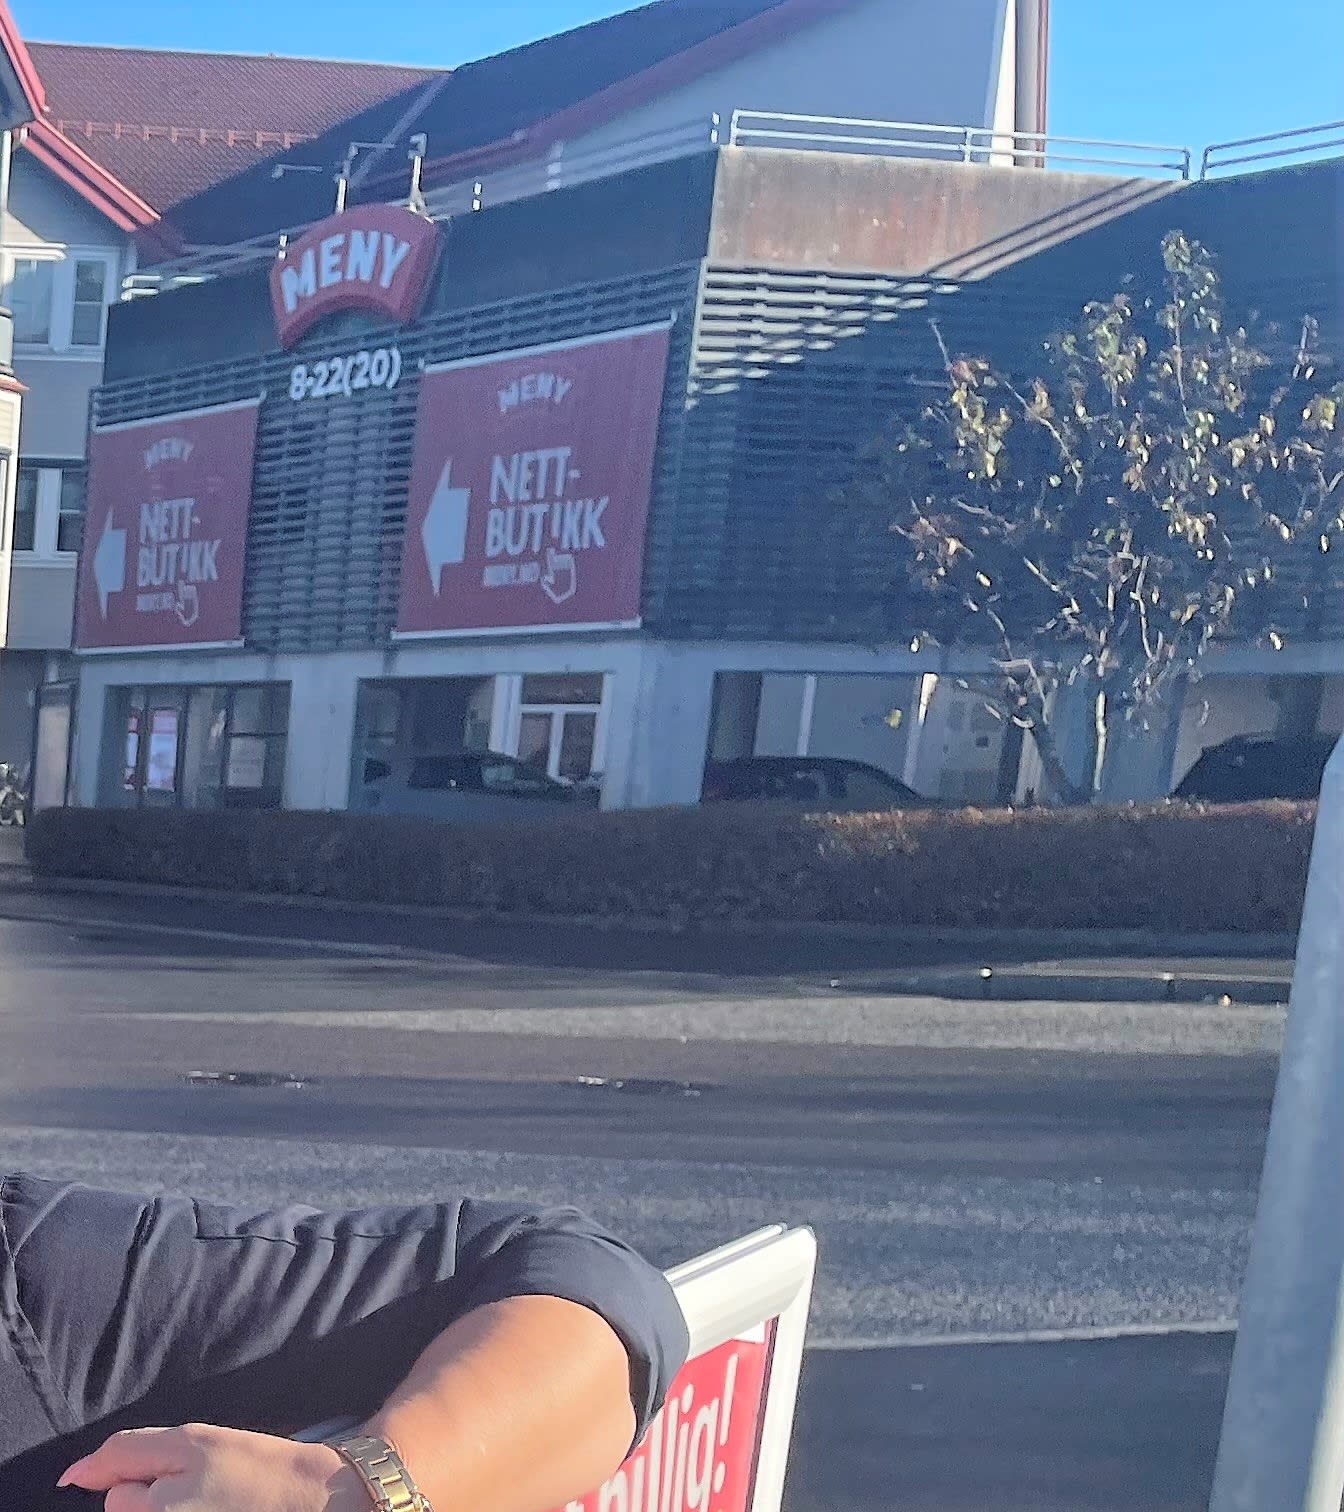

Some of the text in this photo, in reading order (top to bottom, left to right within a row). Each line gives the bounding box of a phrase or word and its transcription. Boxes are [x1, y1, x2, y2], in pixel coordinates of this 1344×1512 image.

[280, 229, 411, 314] MENY
[289, 348, 403, 400] 8-22(20)
[490, 447, 582, 505] NETT-
[140, 497, 202, 544] NETT-
[485, 496, 609, 558] BUTIKK
[137, 538, 222, 587] BUTIKK
